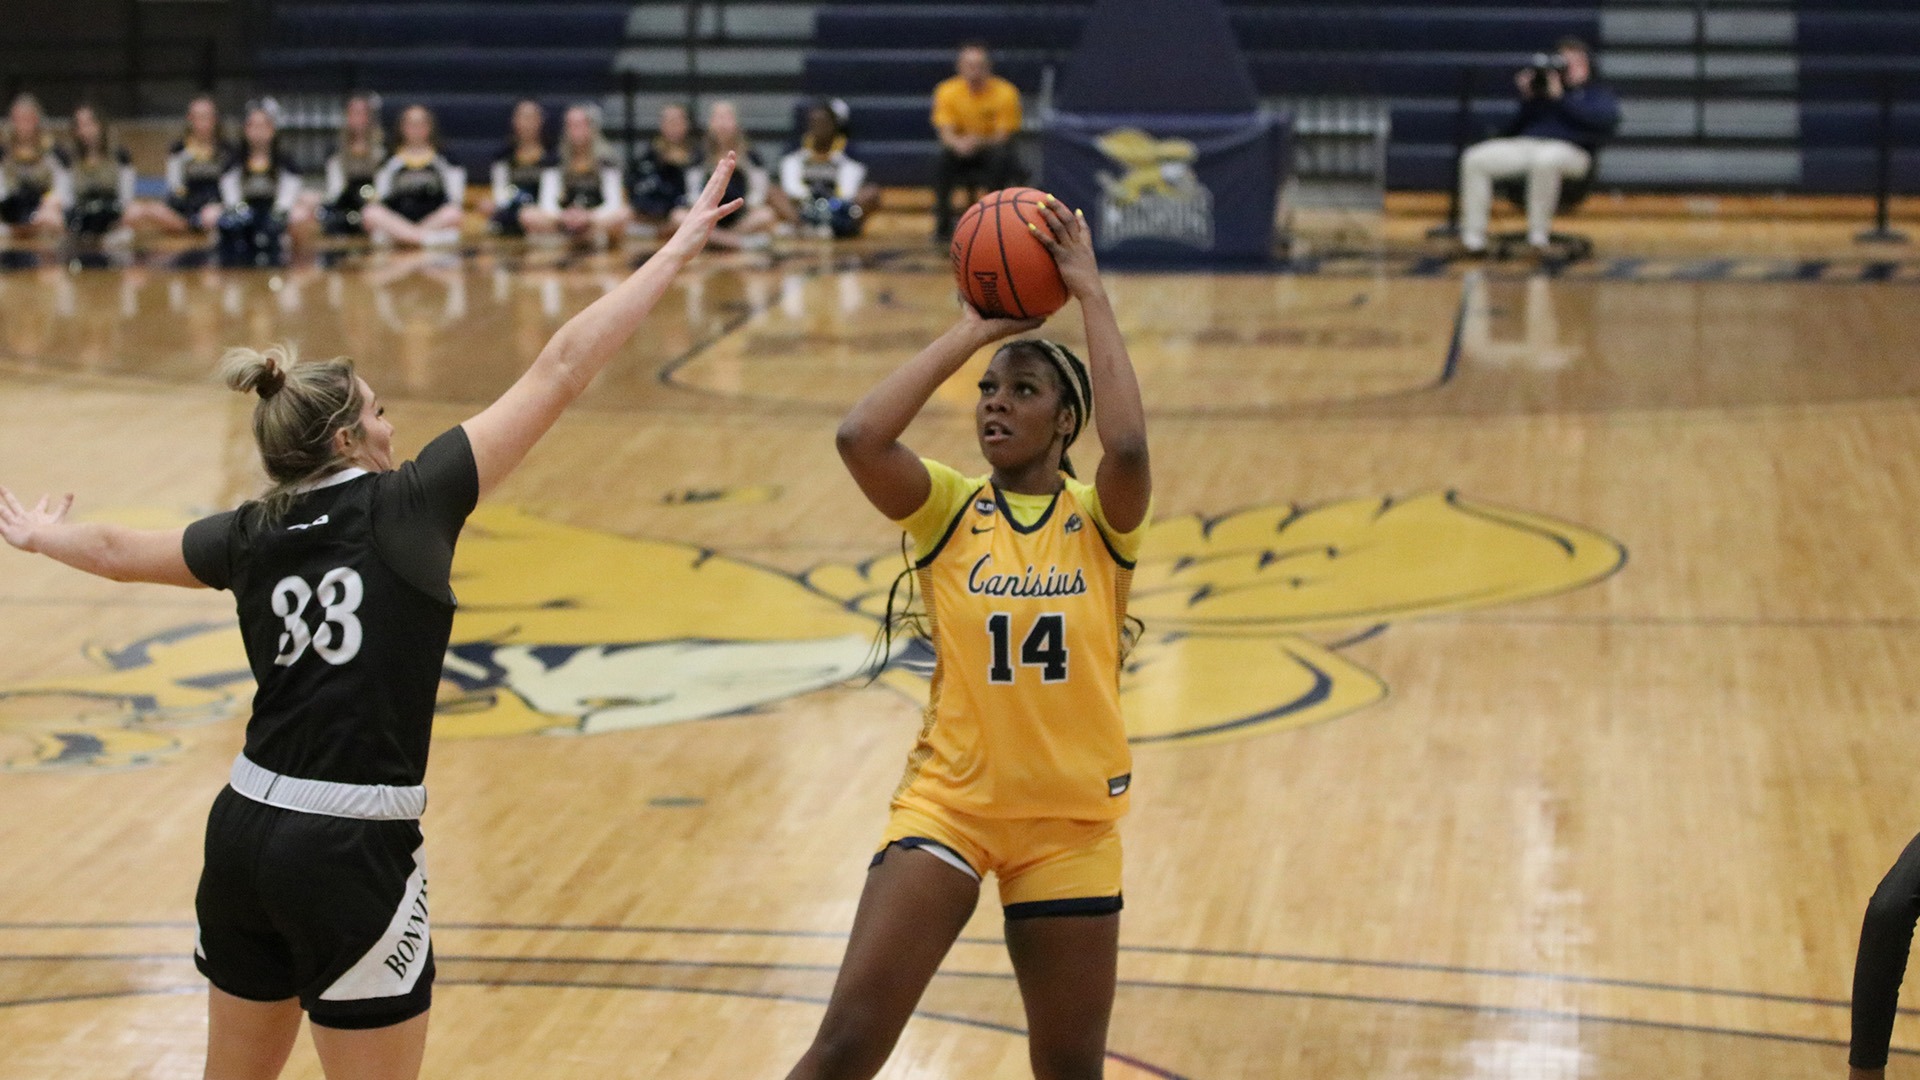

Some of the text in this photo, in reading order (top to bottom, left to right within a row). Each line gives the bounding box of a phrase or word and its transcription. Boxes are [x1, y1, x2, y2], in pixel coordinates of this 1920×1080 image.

[271, 566, 364, 668] 33
[968, 553, 1087, 597] Canisius
[987, 612, 1069, 685] 14
[384, 878, 428, 980] BONNI
